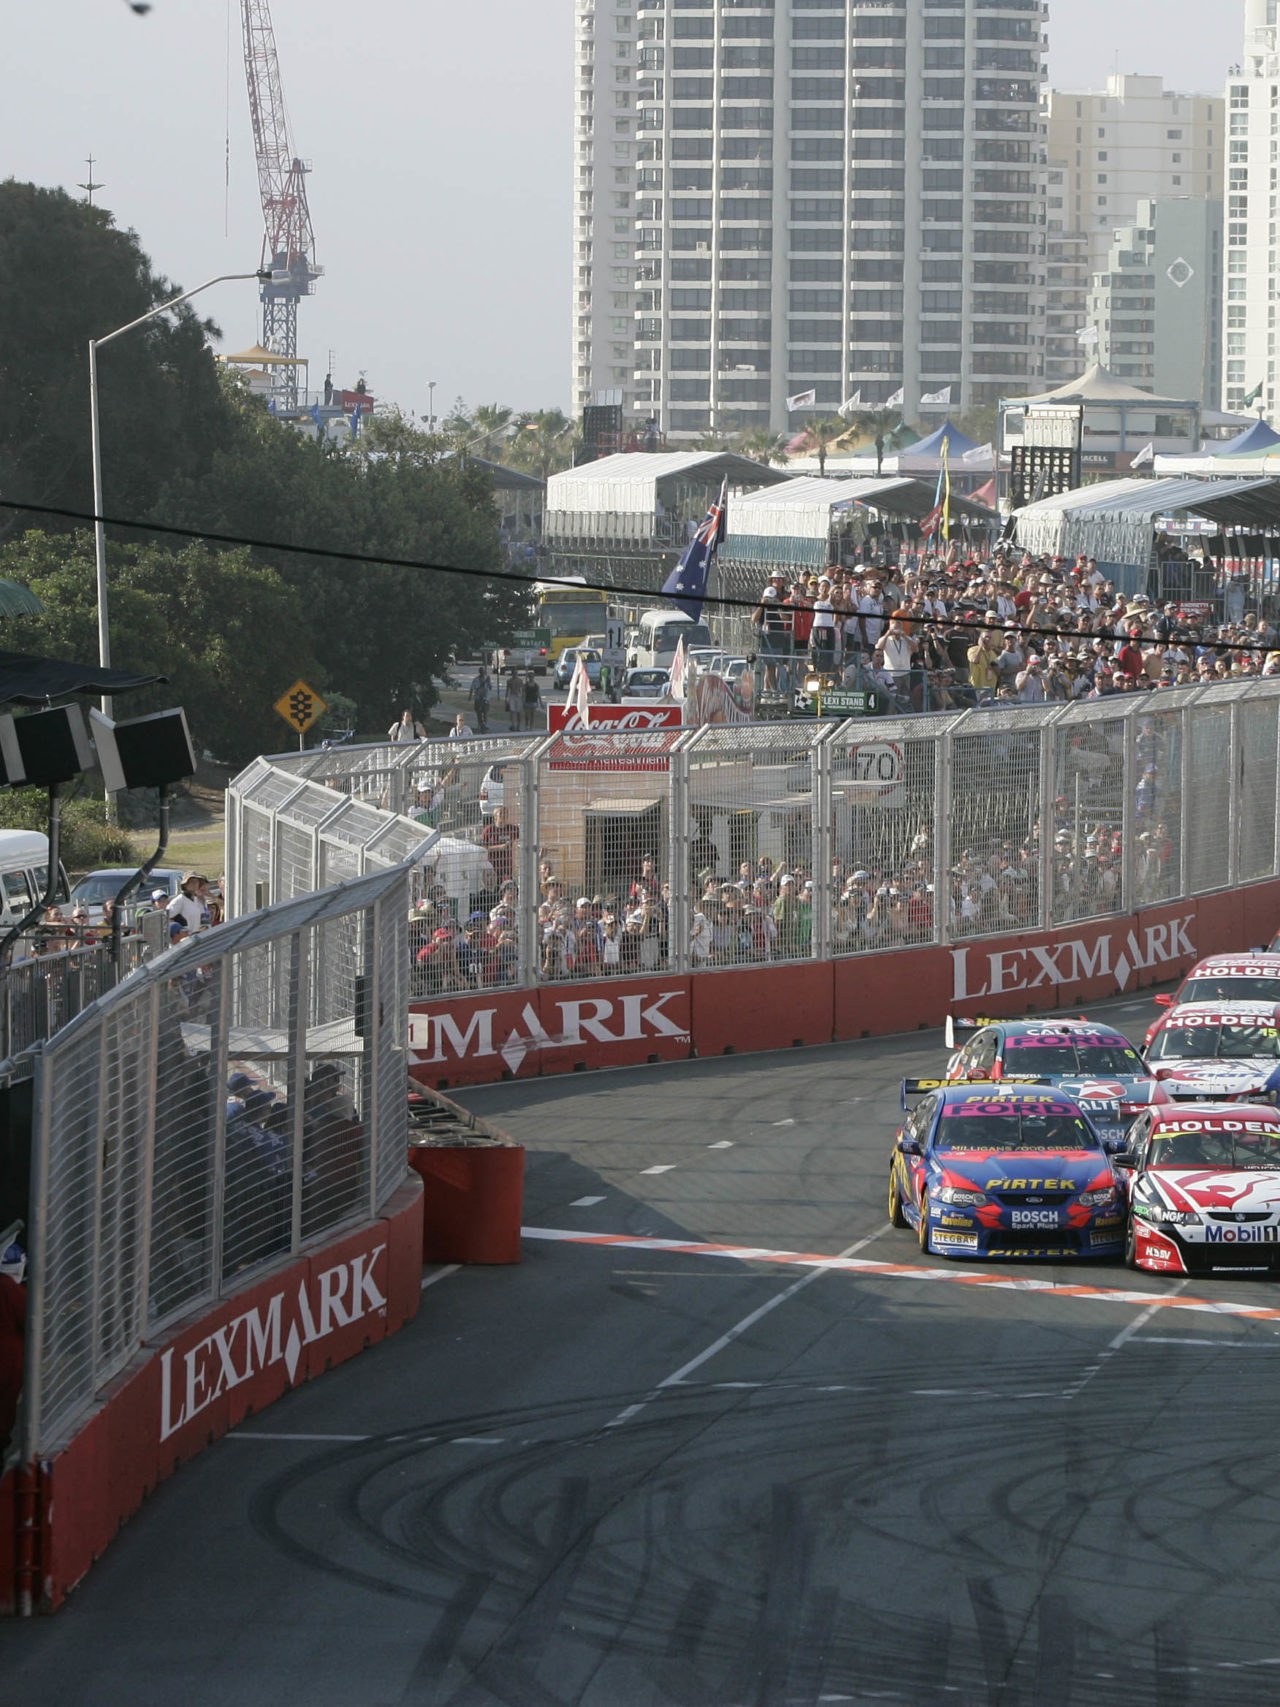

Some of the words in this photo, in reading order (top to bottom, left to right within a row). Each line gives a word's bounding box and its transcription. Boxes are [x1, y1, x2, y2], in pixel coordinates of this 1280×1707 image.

[840, 697, 864, 706] STAND
[868, 693, 875, 709] 4
[858, 752, 894, 780] 70
[950, 914, 1197, 1002] LEXMARK
[1165, 1015, 1277, 1028] HOLDEN
[1261, 1028, 1278, 1037] 15
[1013, 1036, 1121, 1046] FORD
[1124, 1049, 1136, 1059] 9
[965, 1096, 1055, 1104] PIRTEK
[951, 1104, 1072, 1116] FORD
[1074, 1119, 1084, 1130] 1
[985, 1178, 1076, 1190] PIRTEK
[1011, 1210, 1059, 1223] BOSCH
[1161, 1210, 1185, 1222] NGK
[1011, 1222, 1035, 1231] Spark
[1037, 1222, 1059, 1231] Plugs
[934, 1232, 977, 1244] STEGBAR
[1205, 1226, 1262, 1242] Mobil
[1265, 1226, 1276, 1241] 1
[987, 1249, 1080, 1257] PIRTEK
[160, 1243, 387, 1443] LEXMARK
